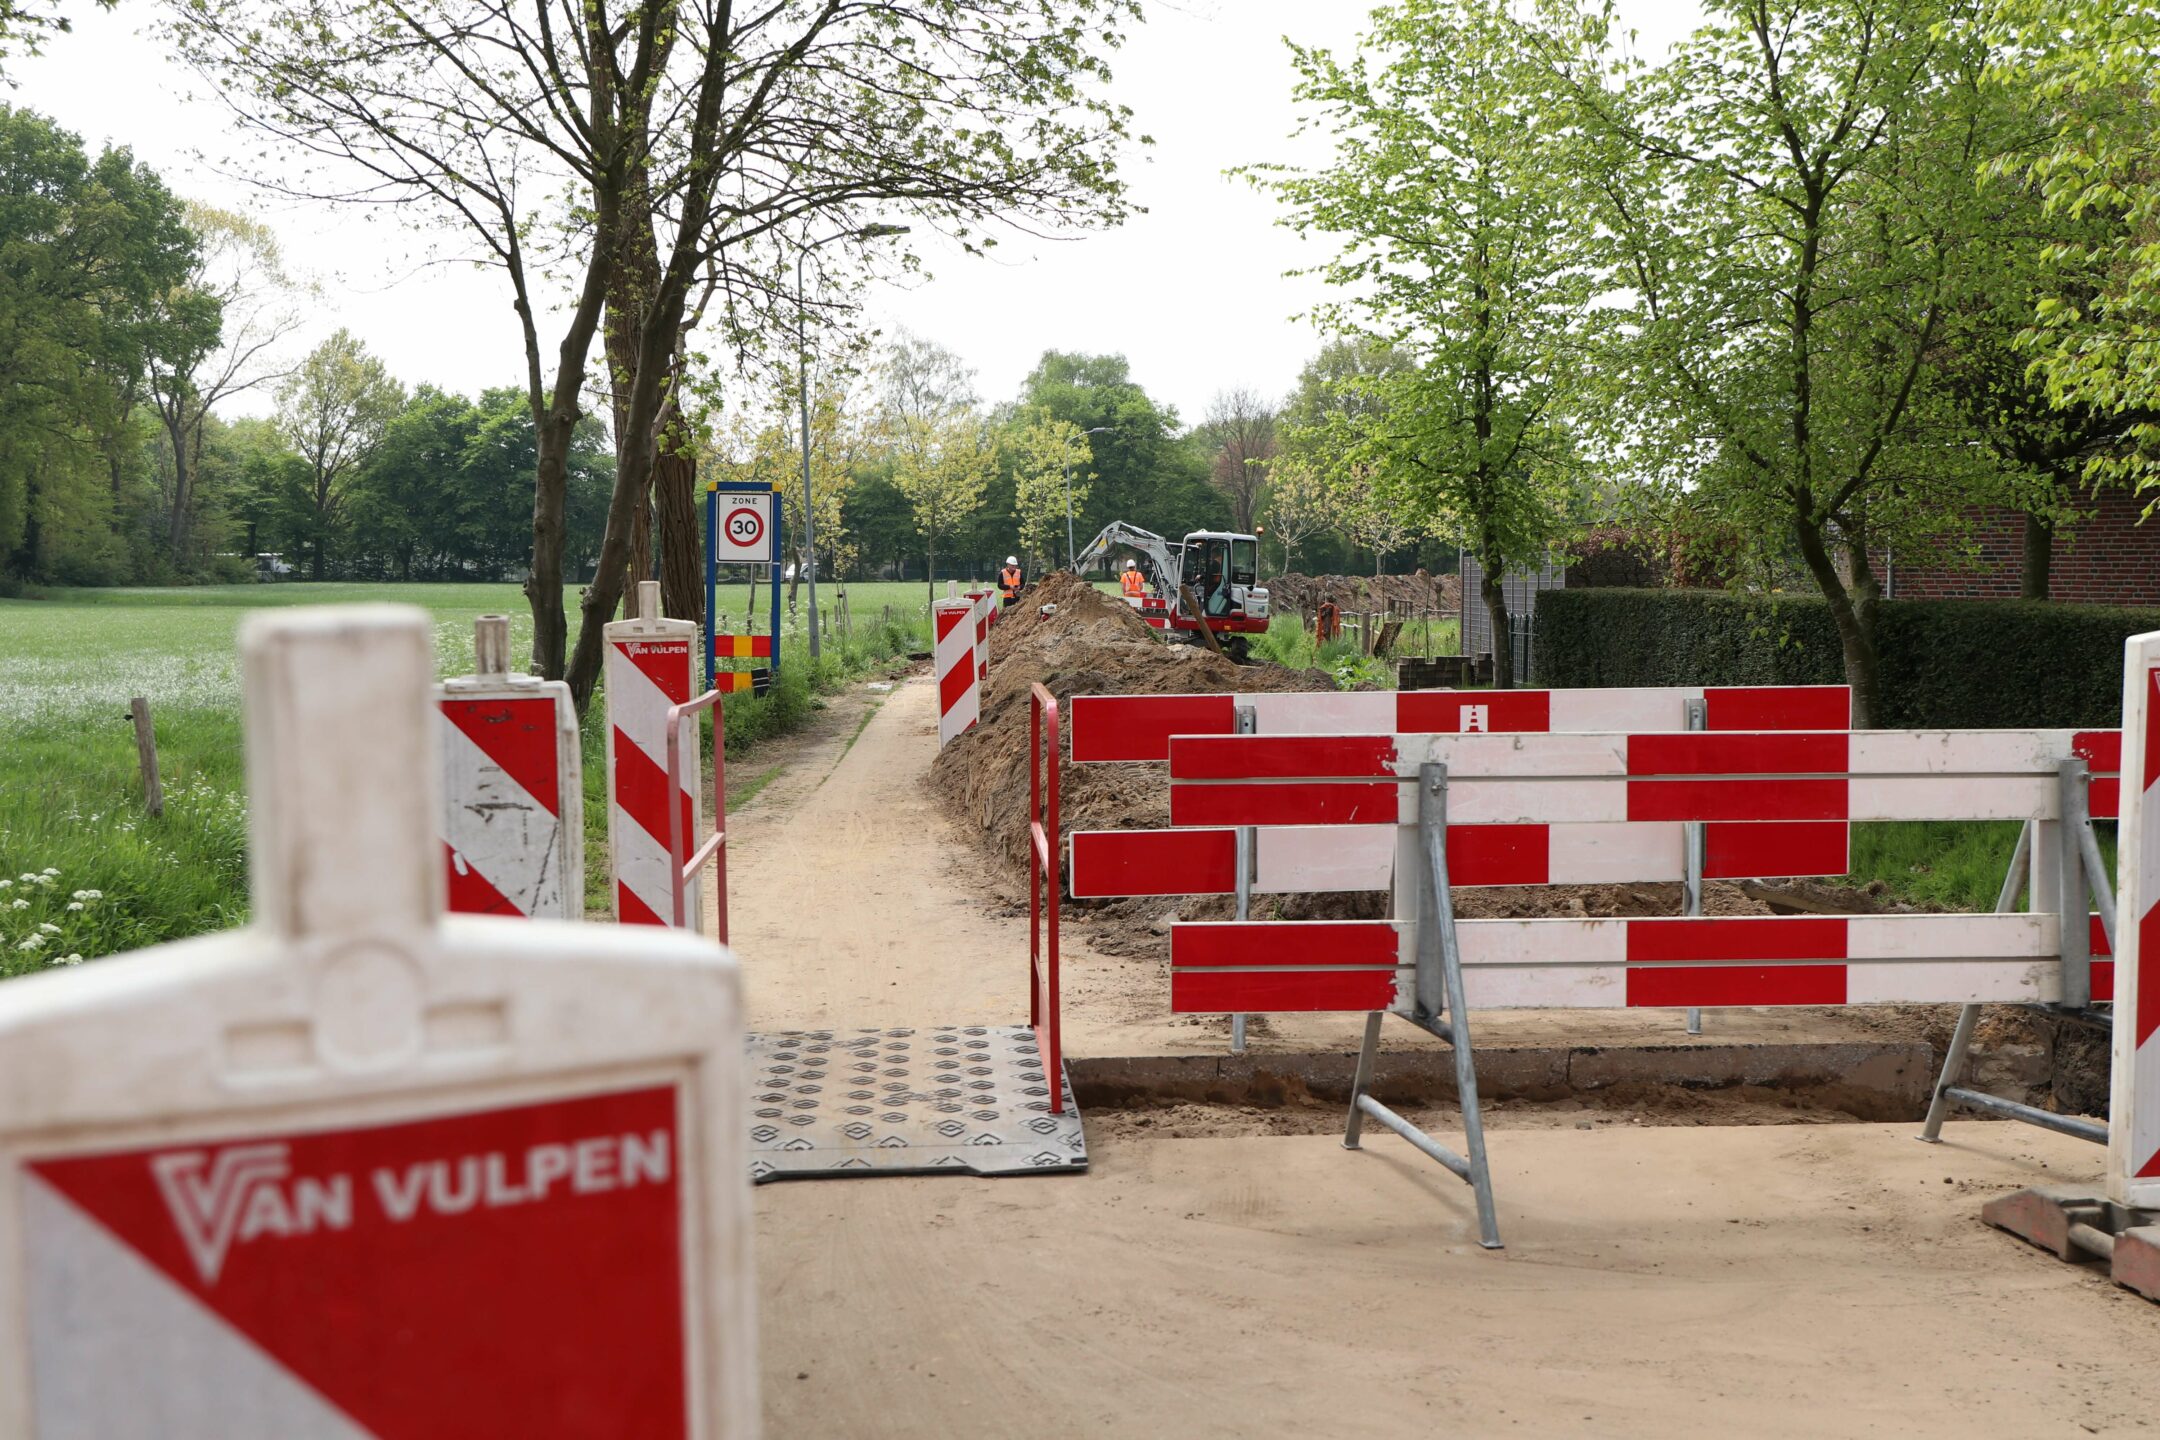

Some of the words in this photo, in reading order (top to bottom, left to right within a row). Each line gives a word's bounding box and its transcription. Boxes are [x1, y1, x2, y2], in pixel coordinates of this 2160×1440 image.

[733, 520, 757, 535] 30
[625, 642, 648, 659] VAN
[651, 646, 687, 654] VULPEN
[149, 1142, 354, 1288] VAN
[370, 1128, 672, 1223] VULPEN
